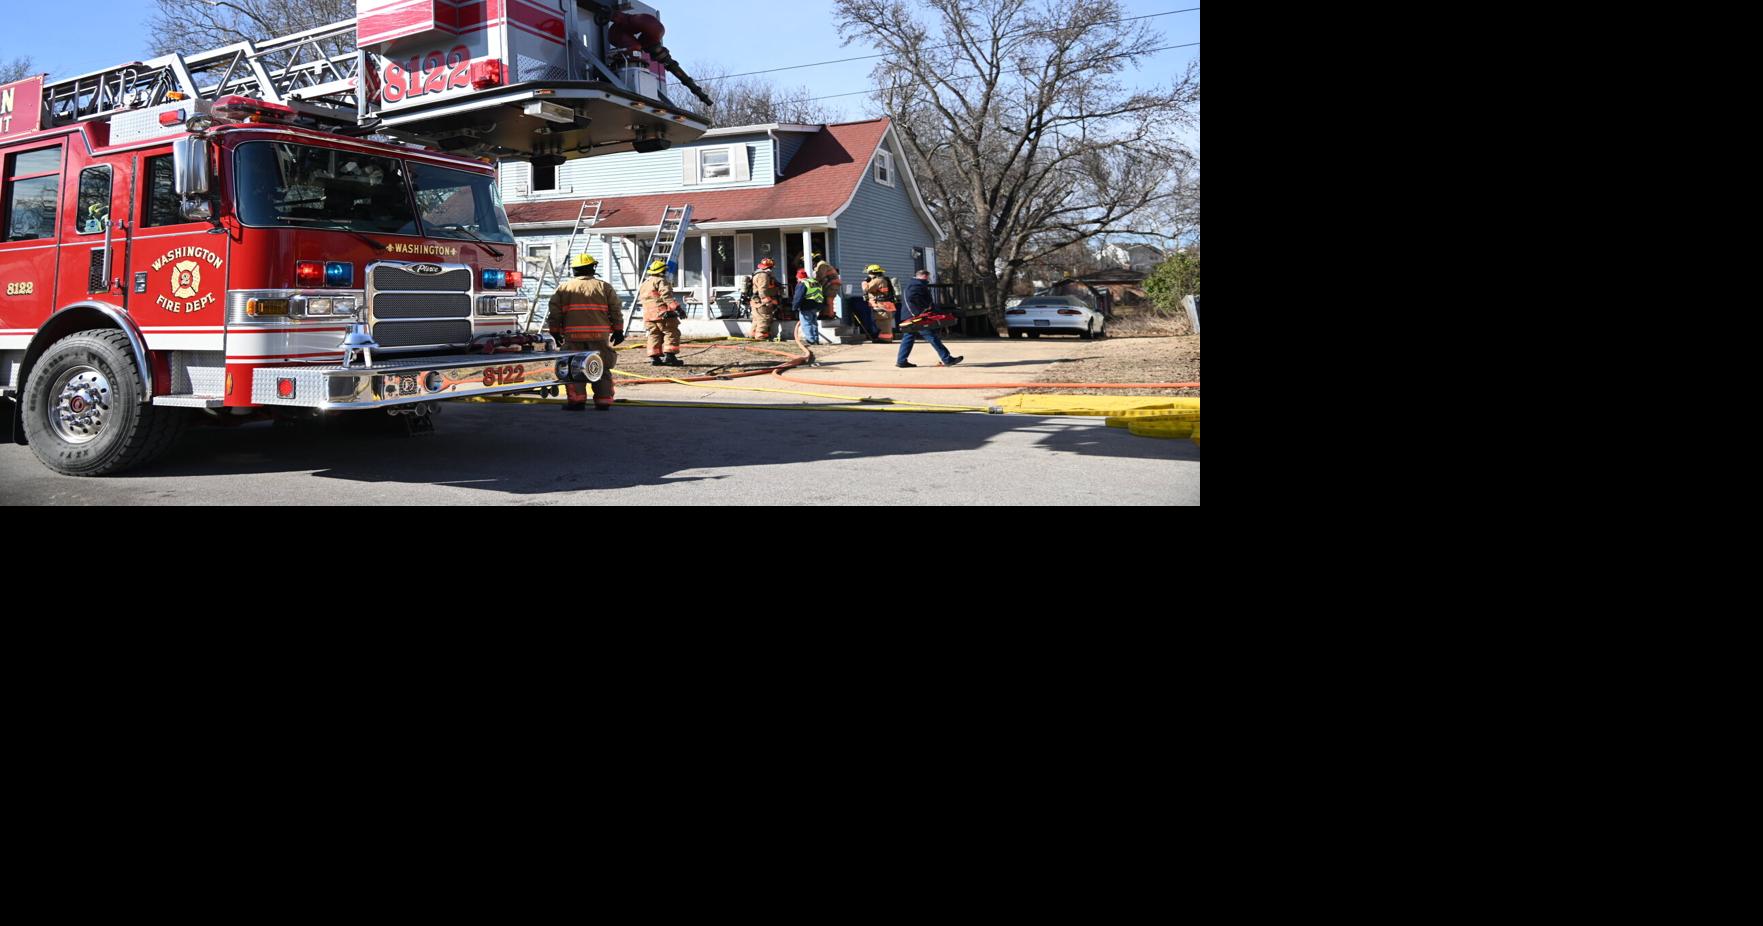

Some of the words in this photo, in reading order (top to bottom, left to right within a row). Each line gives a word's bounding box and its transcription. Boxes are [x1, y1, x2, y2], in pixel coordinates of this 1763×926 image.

[383, 44, 471, 103] 8122
[151, 246, 223, 272] WASHINGTON
[395, 243, 450, 256] WASHINGTON
[6, 281, 34, 296] 8122
[156, 294, 181, 313] FIRE
[185, 292, 216, 313] DEPT.
[482, 364, 525, 387] 8122
